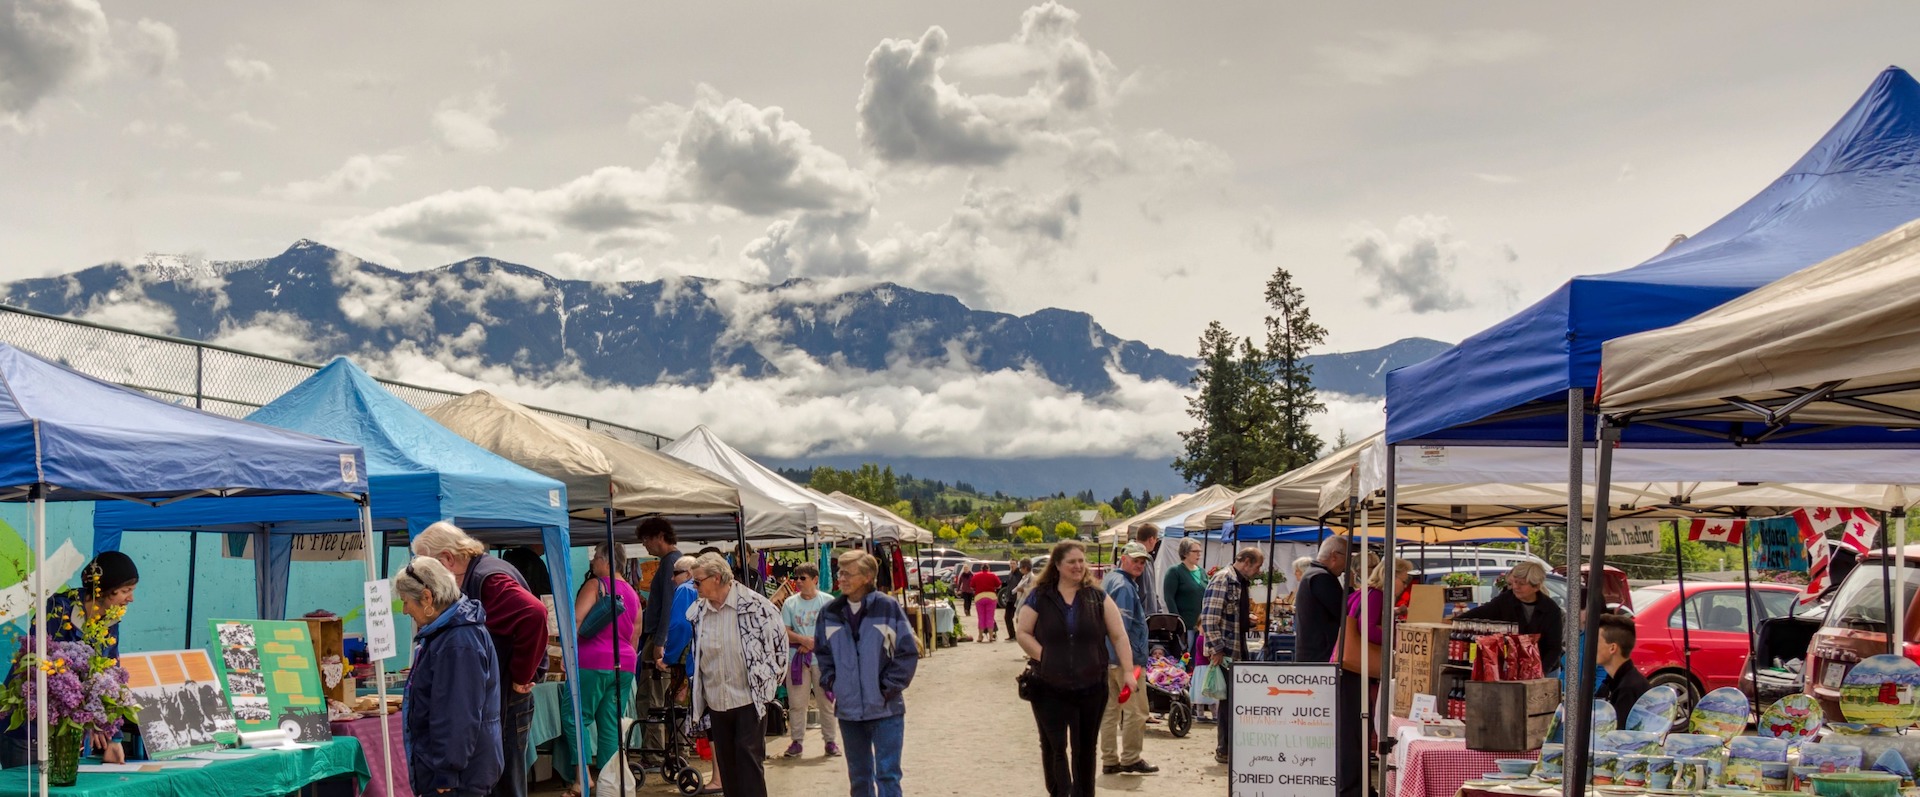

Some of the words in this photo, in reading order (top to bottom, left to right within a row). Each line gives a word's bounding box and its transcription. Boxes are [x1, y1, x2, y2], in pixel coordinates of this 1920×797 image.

[1621, 525, 1654, 548] Trading
[1401, 631, 1428, 644] LOCA
[1399, 643, 1428, 656] JUICE
[1236, 673, 1269, 684] LOCA
[1277, 674, 1336, 686] ORCHARD
[1235, 705, 1283, 716] CHERRY
[1292, 707, 1330, 717] JUICE
[1278, 752, 1286, 763] &
[1238, 773, 1274, 784] DRIED
[1278, 774, 1336, 786] CHERRIES
